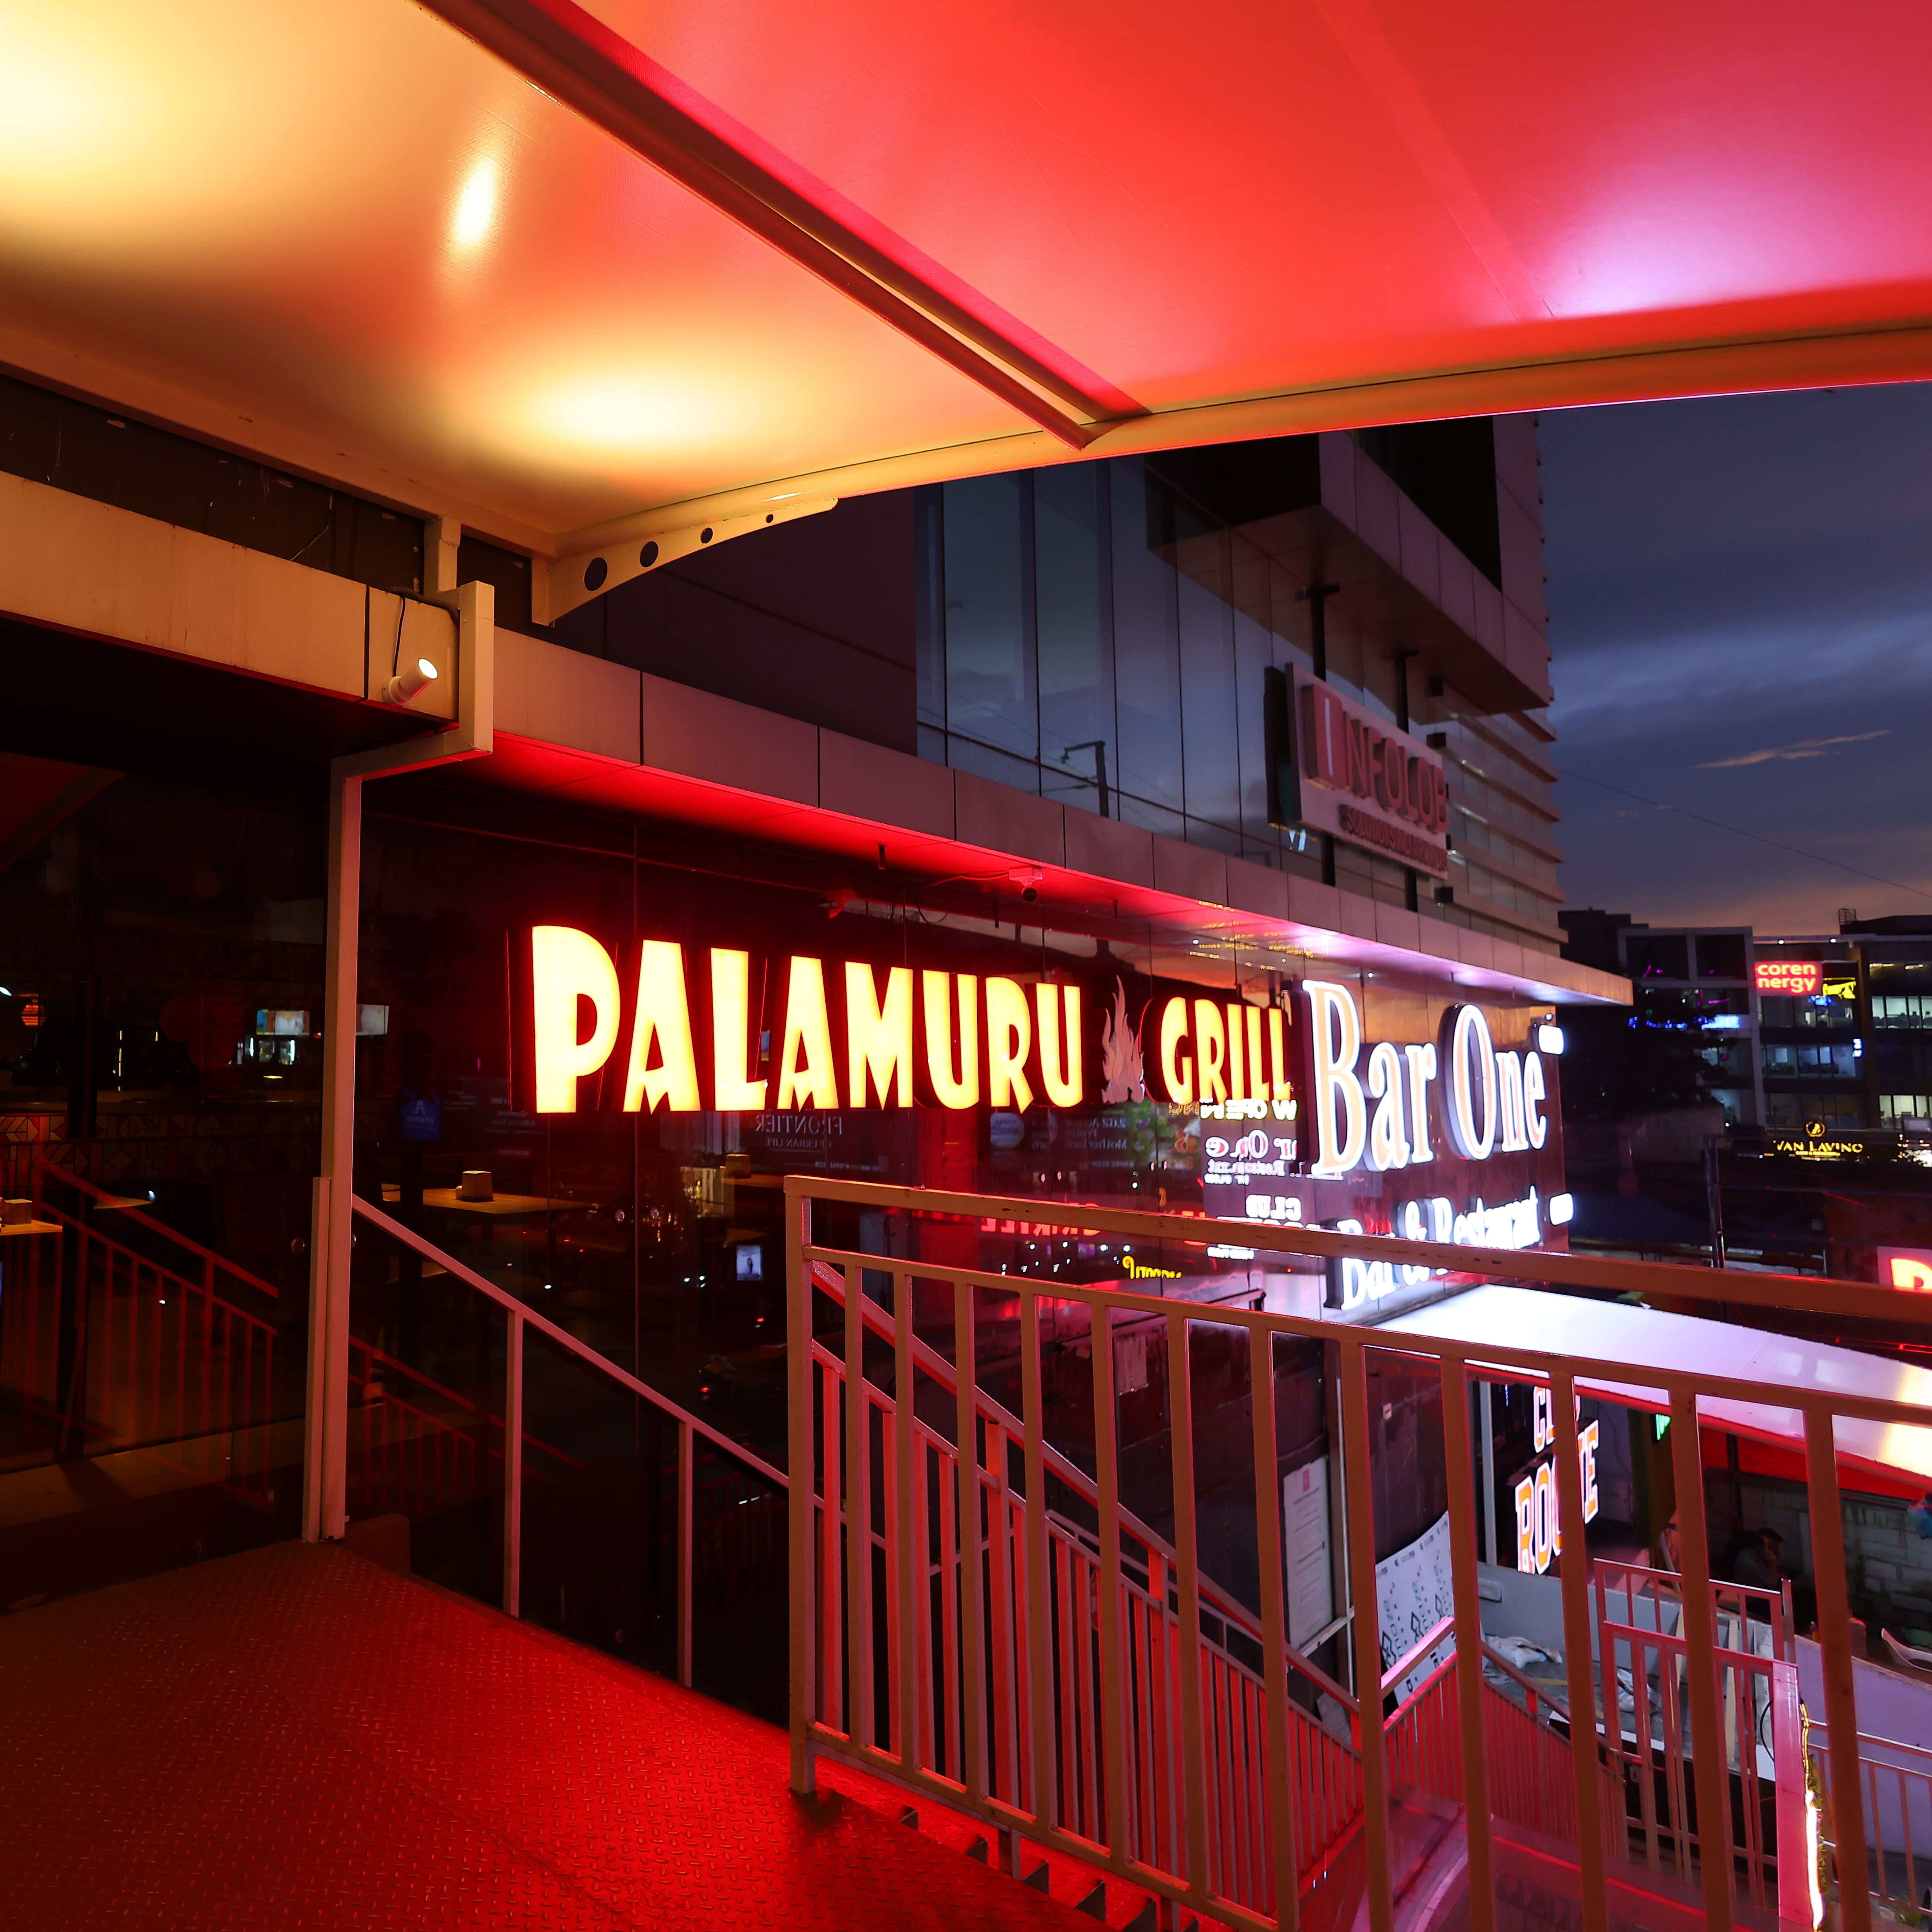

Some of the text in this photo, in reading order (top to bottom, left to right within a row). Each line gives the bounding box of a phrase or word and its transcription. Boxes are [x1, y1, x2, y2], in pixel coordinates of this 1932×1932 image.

[1313, 684, 1449, 834] INFOLOB
[532, 925, 1292, 1114] PALAMURU GRILL
[1302, 979, 1546, 1175] Bar One
[1773, 1140, 1804, 1151] VAN
